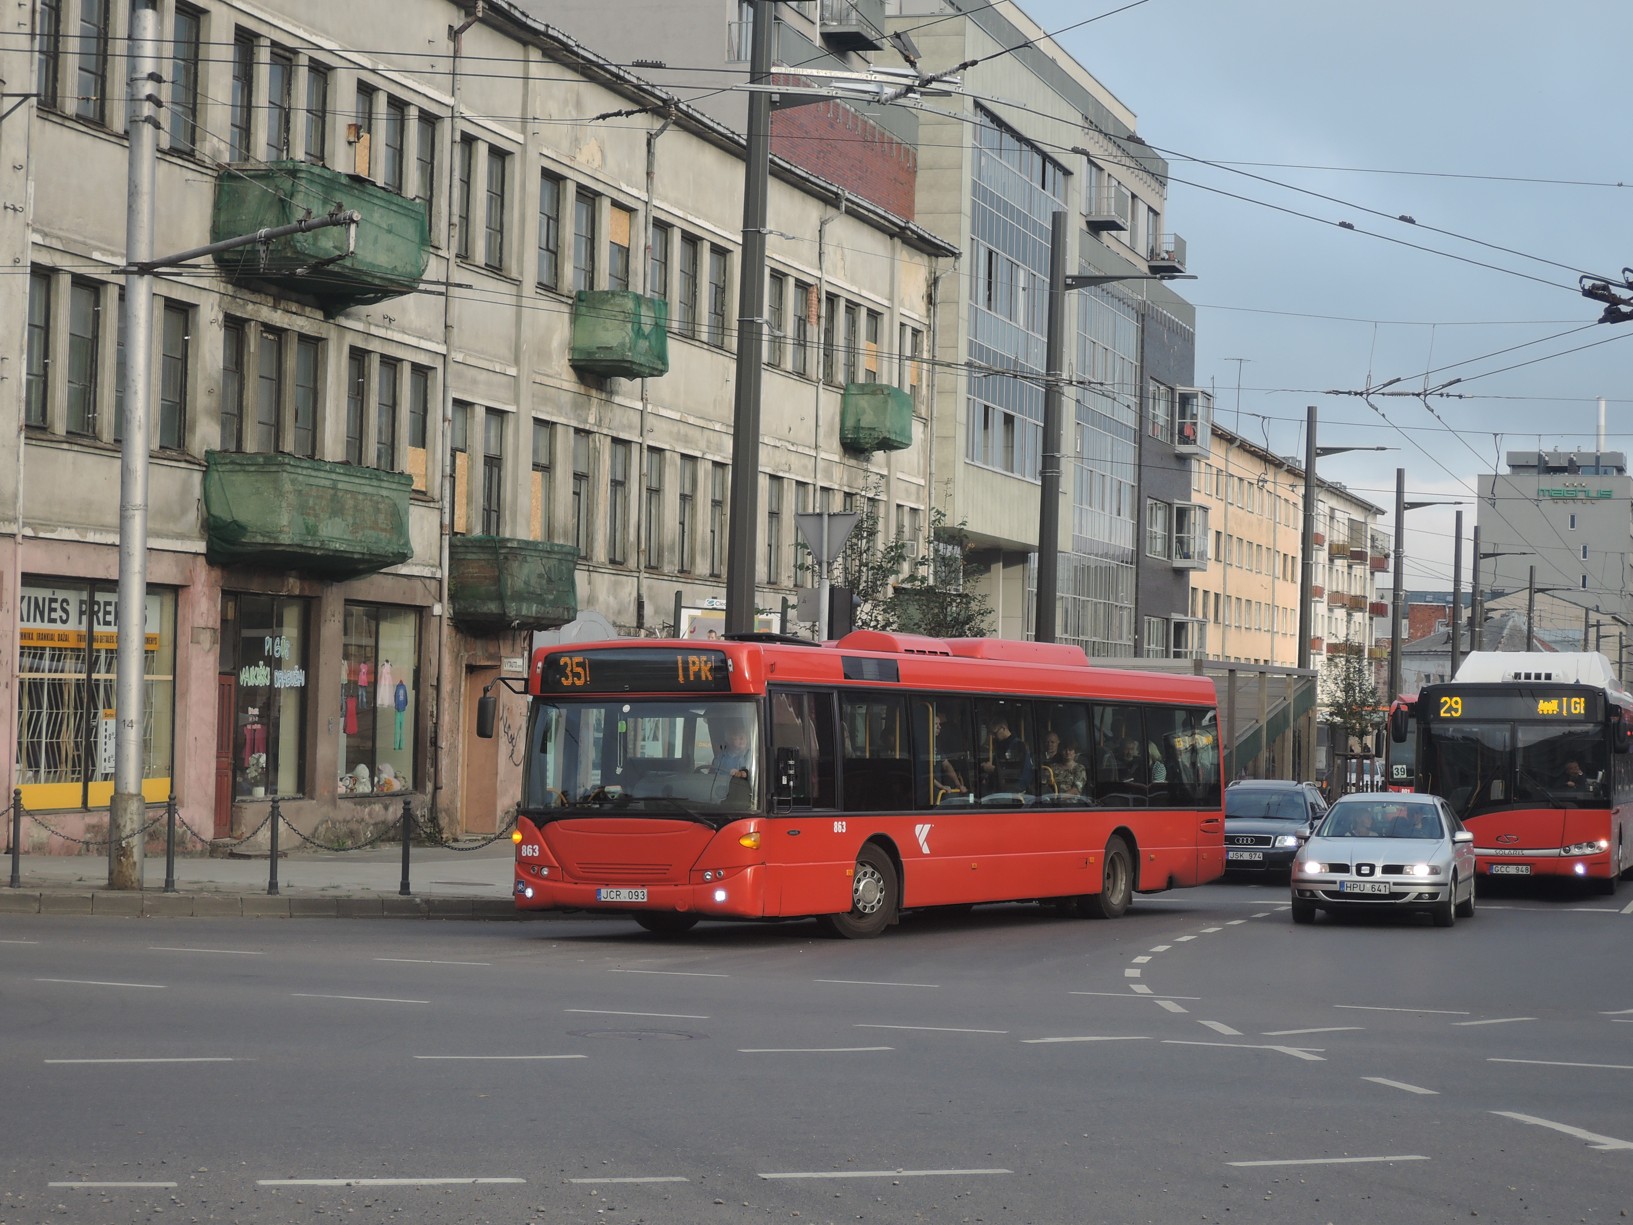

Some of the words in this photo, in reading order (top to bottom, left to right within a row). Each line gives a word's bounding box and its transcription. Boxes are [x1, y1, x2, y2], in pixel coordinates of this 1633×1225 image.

[1440, 696, 1462, 717] 29
[122, 719, 134, 730] 14
[1394, 767, 1406, 777] 39
[833, 821, 847, 833] 863
[521, 844, 540, 857] 863
[1345, 883, 1365, 892] HPU
[1370, 884, 1387, 893] 641
[602, 890, 622, 900] JCR
[627, 890, 646, 900] 093
